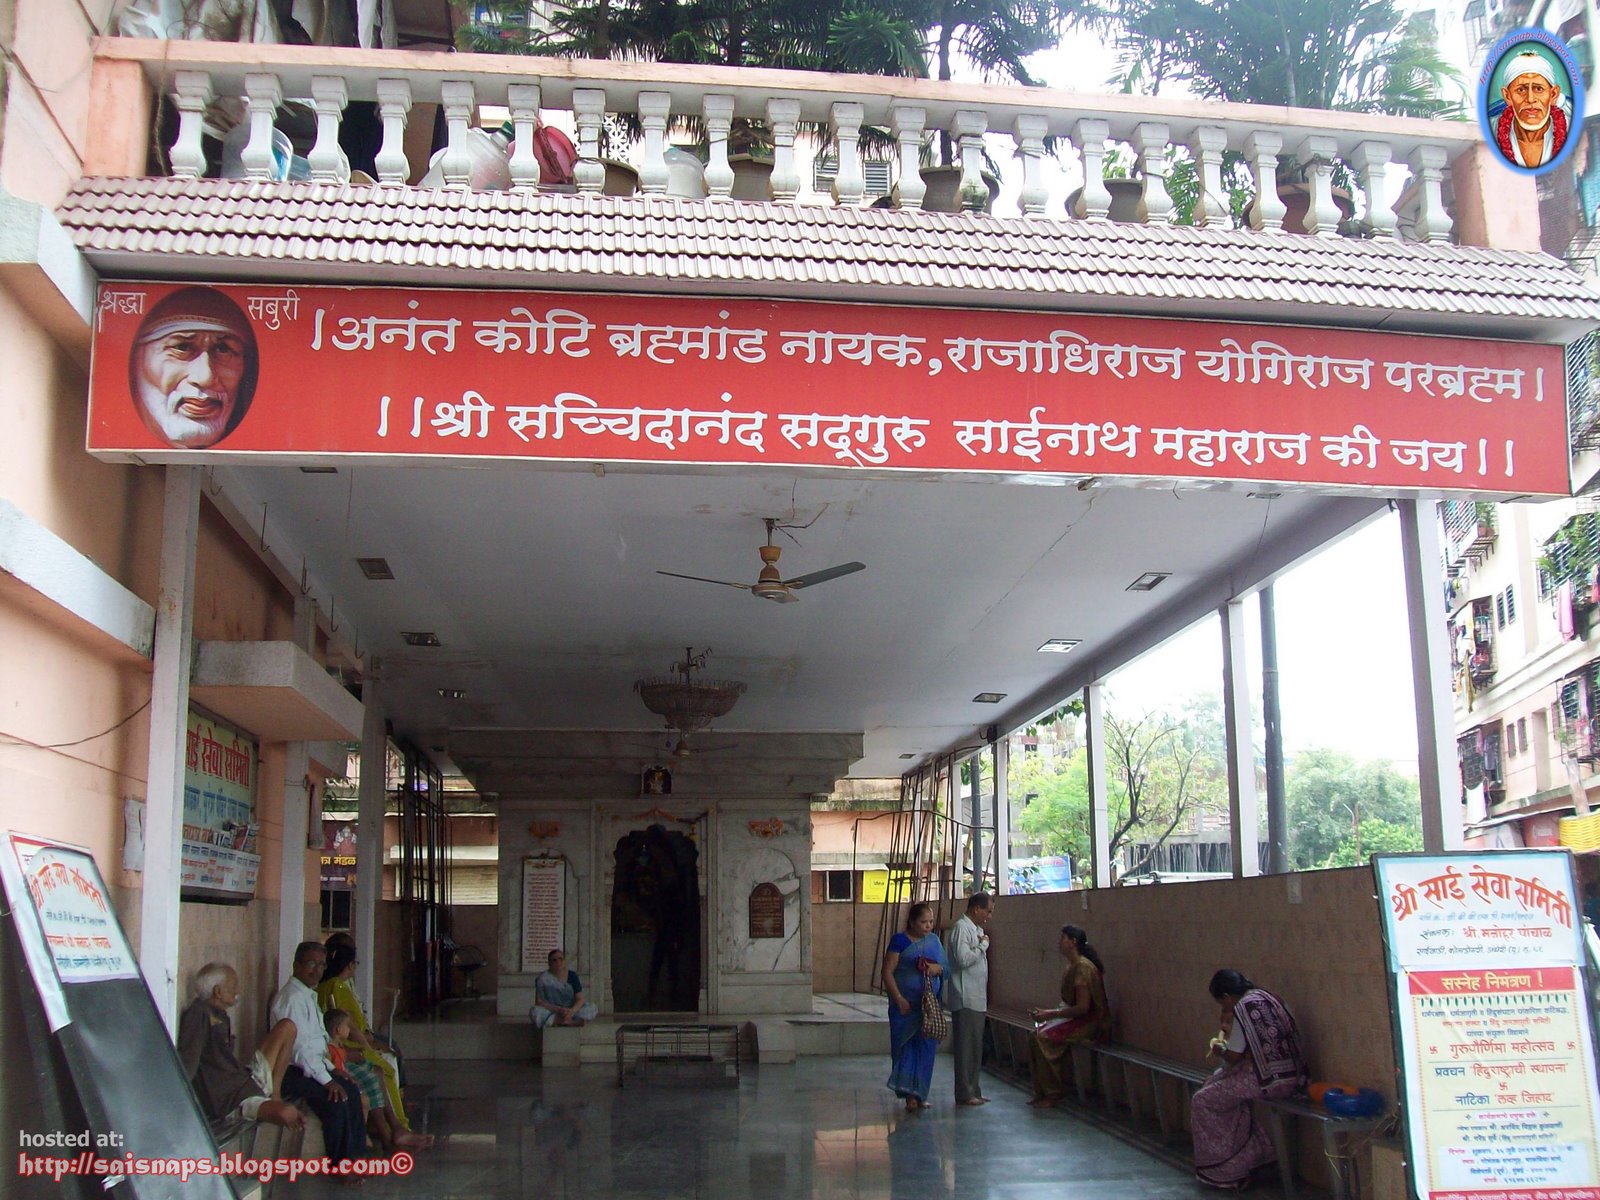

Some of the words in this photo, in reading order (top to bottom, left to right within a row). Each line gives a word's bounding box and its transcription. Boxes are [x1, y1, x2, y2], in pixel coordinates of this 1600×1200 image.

[247, 288, 301, 331] सबुरी
[472, 307, 597, 358] कोटि
[943, 329, 1187, 380] राजाधिराज
[1194, 338, 1375, 391] योगिराज
[505, 391, 769, 454] सच्चिदानंद
[952, 406, 1142, 464] साईनाथ
[1150, 426, 1312, 468] महाराज
[1319, 423, 1382, 470] की
[1392, 884, 1419, 921] श्री
[1418, 866, 1467, 909] साई
[1469, 864, 1512, 904] सेवा
[1515, 877, 1572, 929] समिती
[1441, 974, 1482, 991] सस्नेह
[1485, 971, 1531, 990] निमंत्रण
[1511, 1038, 1555, 1053] महोत्सव
[1435, 1066, 1466, 1077] प्रवचन
[1455, 1092, 1490, 1106] नाटिका
